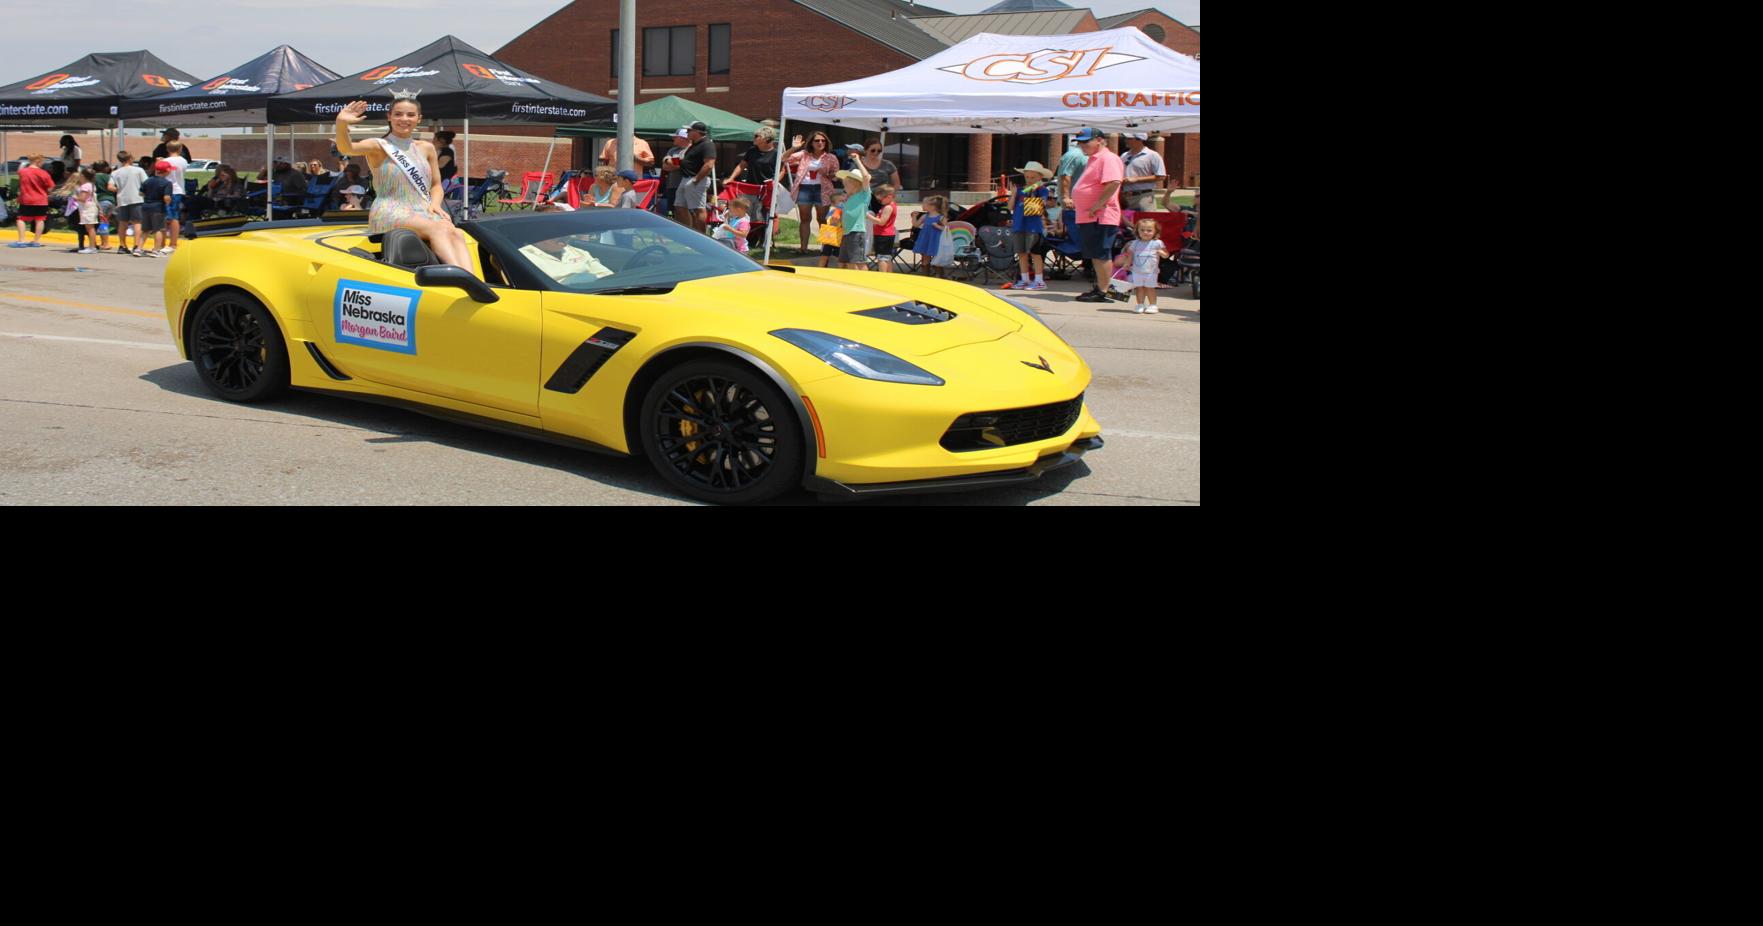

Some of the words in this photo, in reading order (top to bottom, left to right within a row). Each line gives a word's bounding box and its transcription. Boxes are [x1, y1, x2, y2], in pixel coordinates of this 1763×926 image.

[962, 46, 1113, 81] CSI
[159, 101, 227, 113] firstinterstate.com
[1062, 90, 1200, 108] CSITRAFFIC
[512, 102, 586, 117] firstinterstate.com
[392, 150, 410, 168] Miss
[343, 289, 372, 306] Miss
[342, 303, 405, 326] Nebraska
[341, 319, 378, 337] Morgan
[379, 325, 408, 342] Baird
